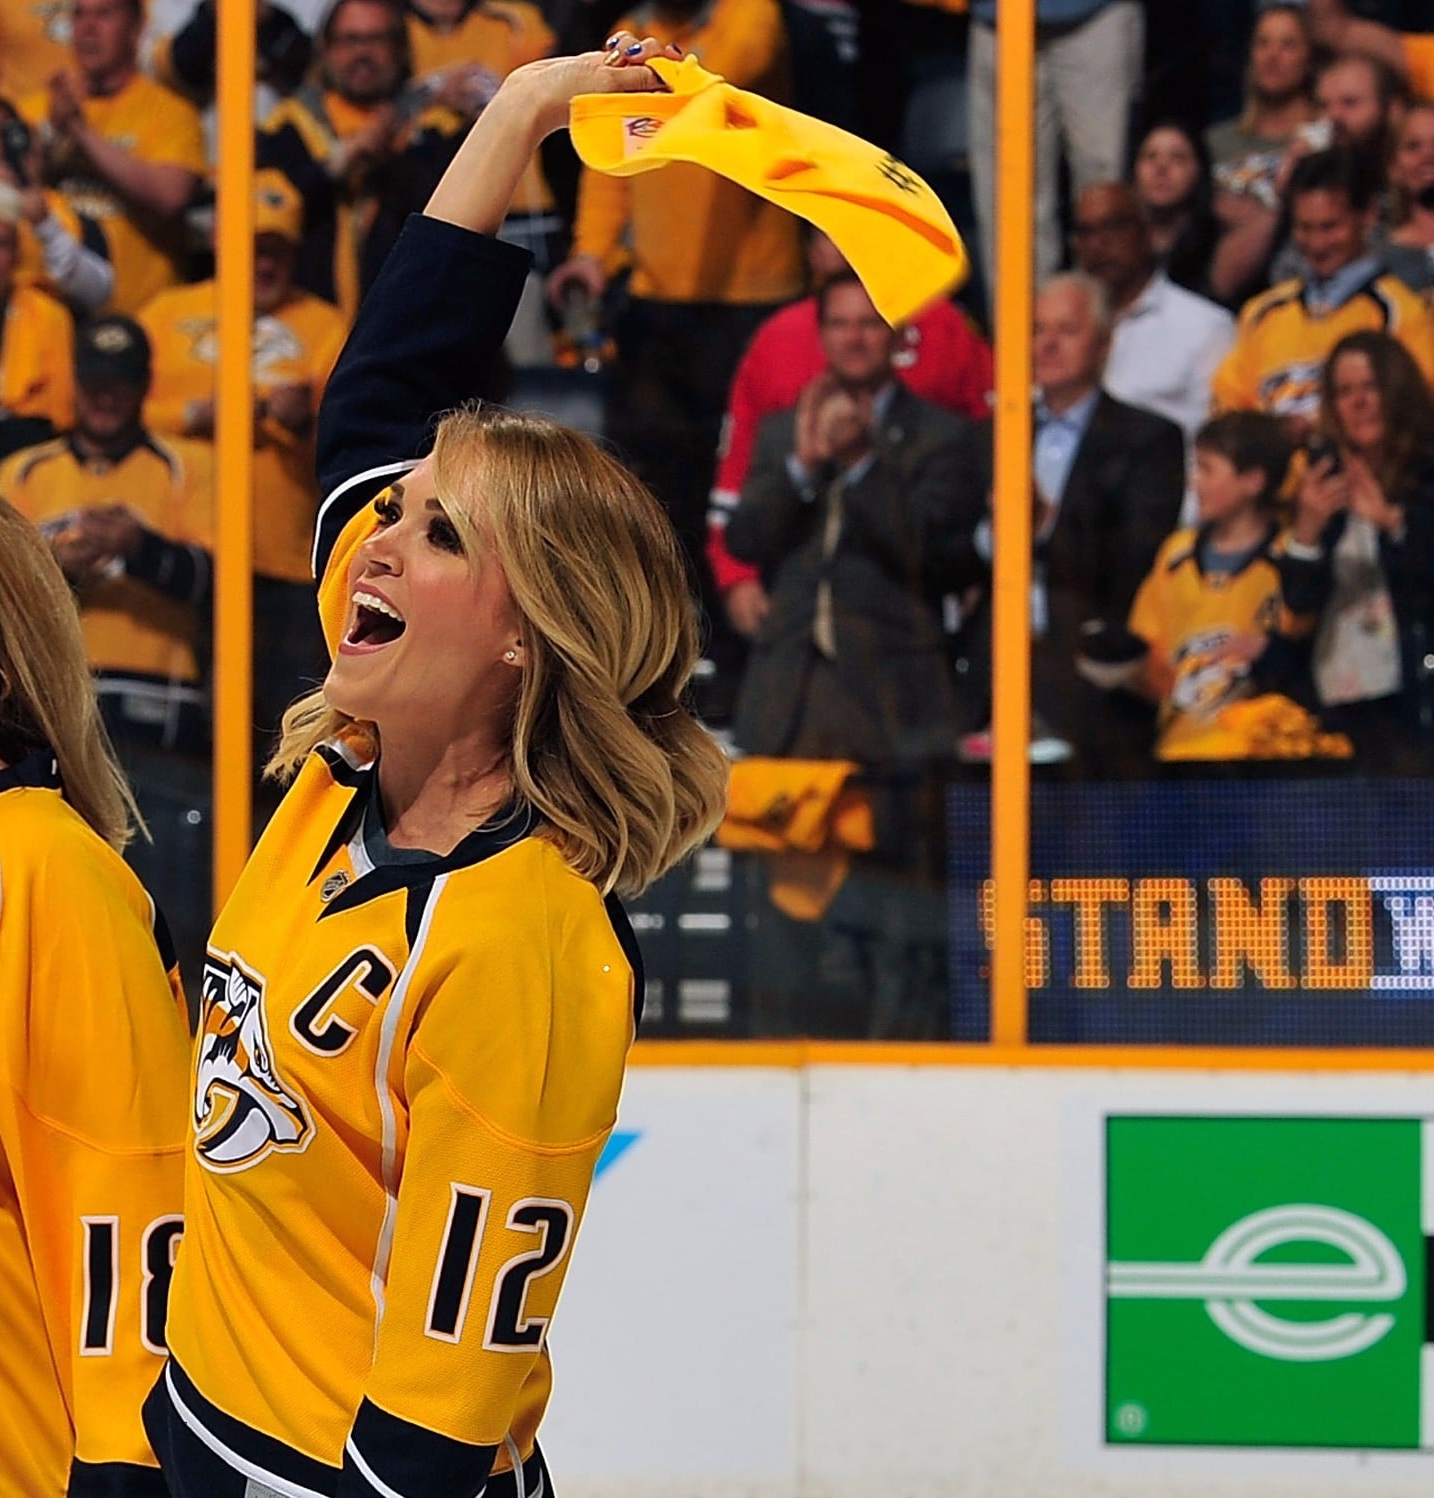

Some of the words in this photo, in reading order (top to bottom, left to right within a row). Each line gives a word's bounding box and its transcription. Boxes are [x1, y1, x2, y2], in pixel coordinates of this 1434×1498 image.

[980, 878, 1373, 990] STAND
[289, 944, 398, 1057] C
[79, 1214, 184, 1357] 18
[424, 1181, 574, 1354] 12
